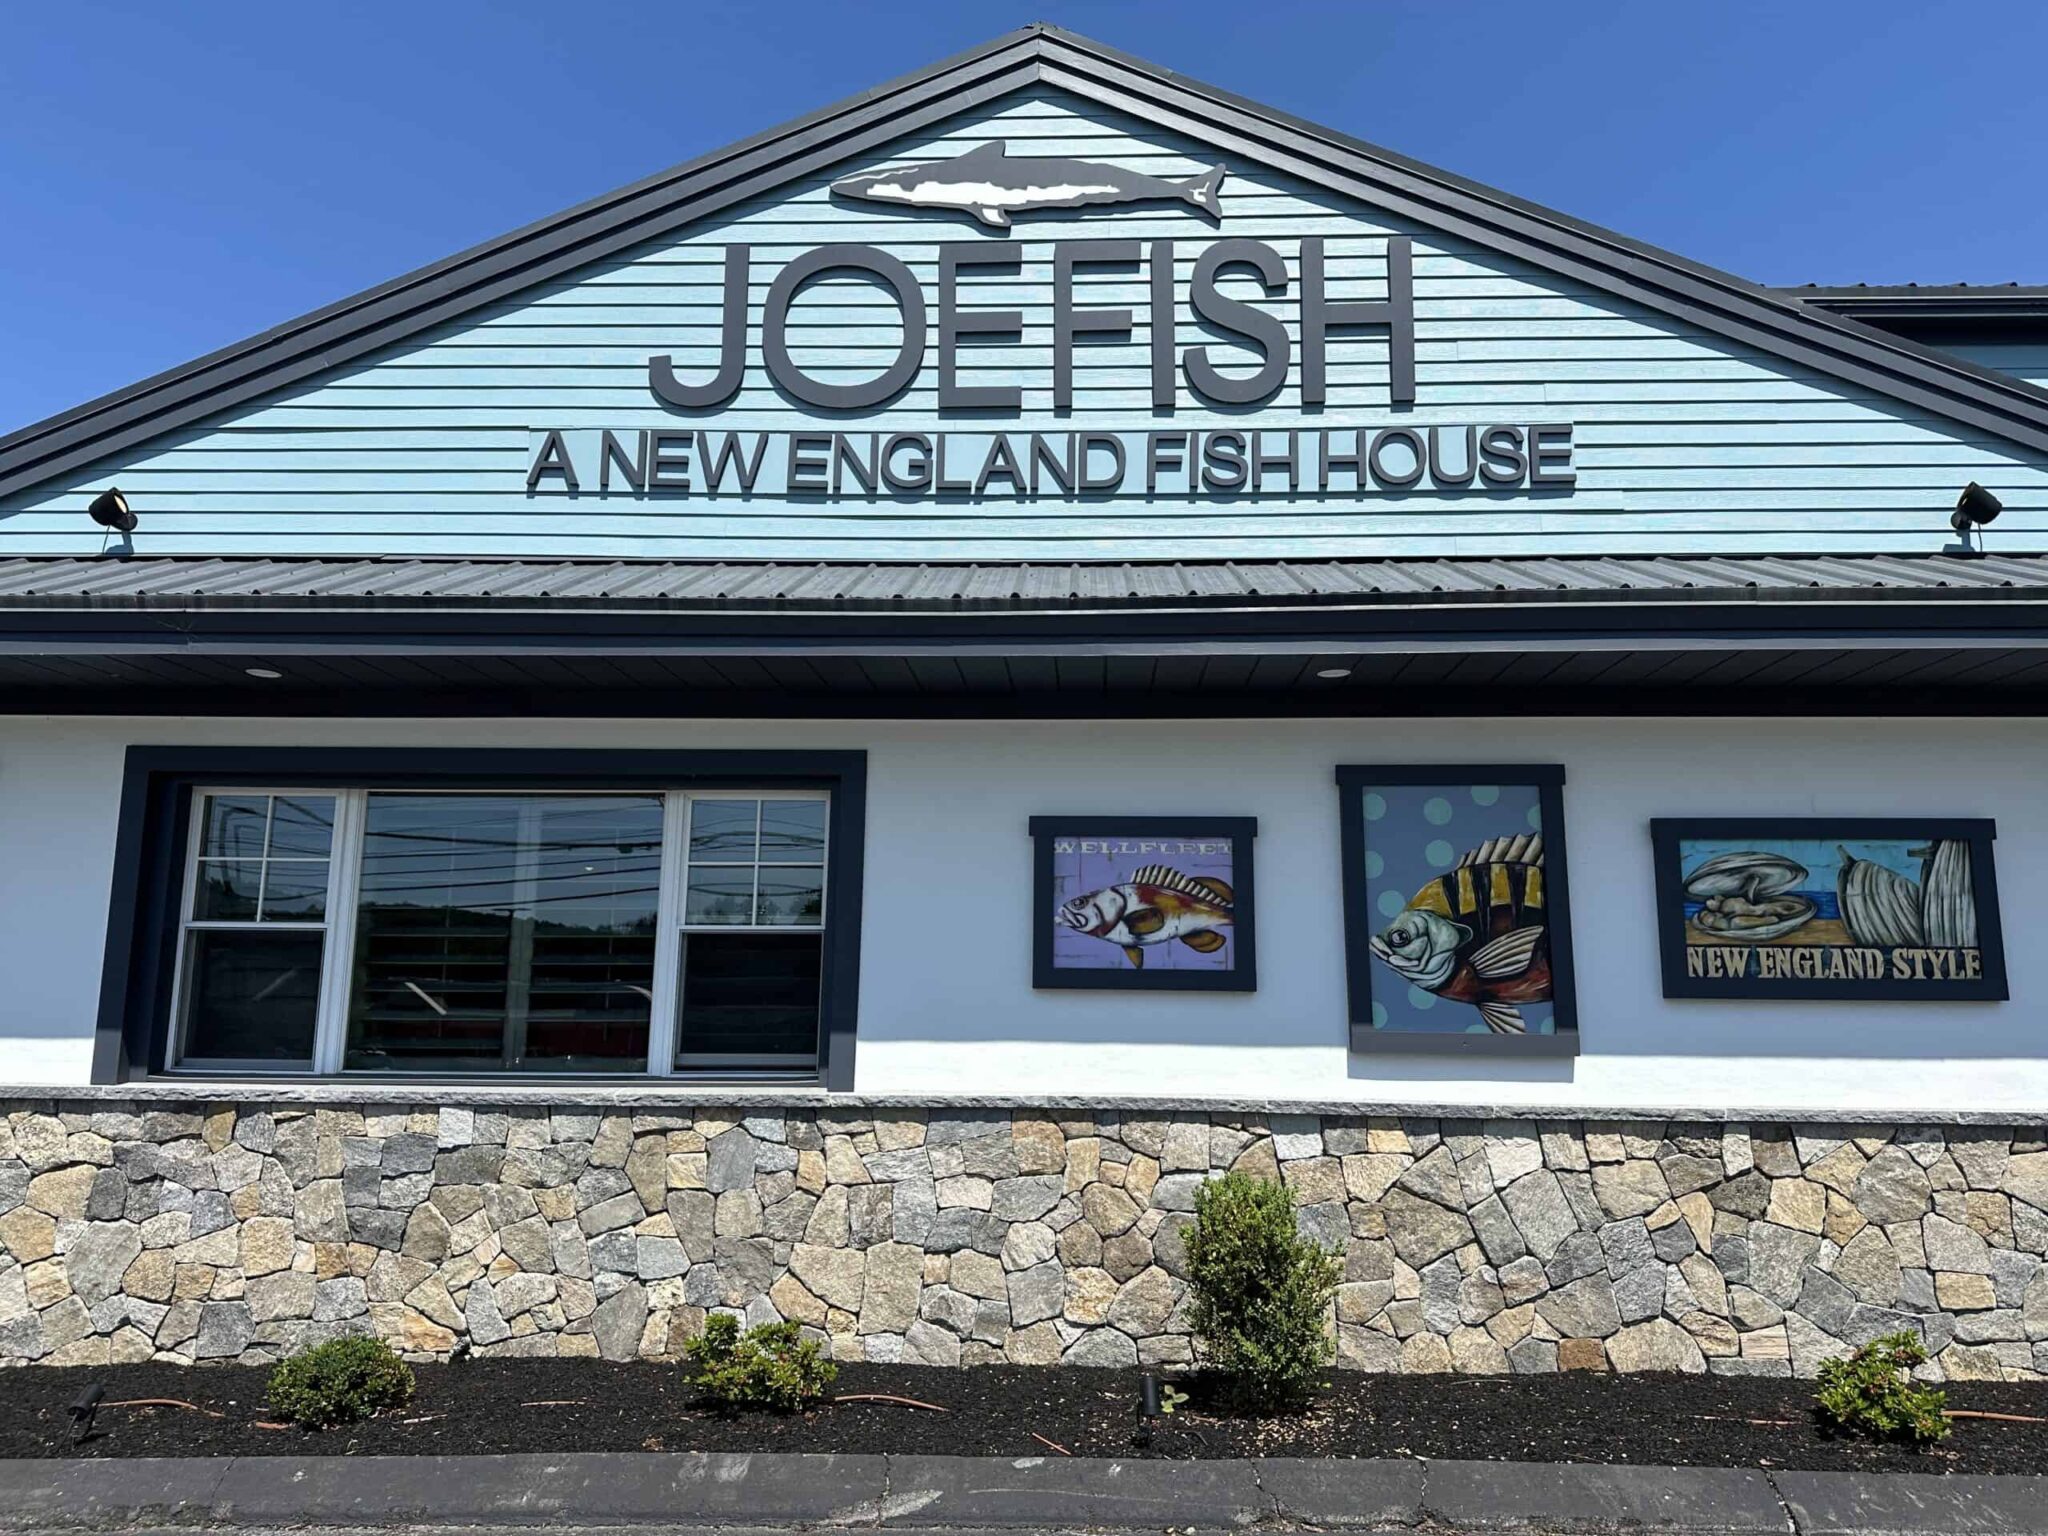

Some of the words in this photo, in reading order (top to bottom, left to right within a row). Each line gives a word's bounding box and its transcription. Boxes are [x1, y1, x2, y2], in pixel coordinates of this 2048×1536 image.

[649, 243, 1022, 408] JOE
[1053, 236, 1415, 406] FISH
[526, 430, 580, 487] A
[600, 430, 769, 488] NEW
[787, 430, 1126, 491] ENGLAND
[1147, 430, 1299, 488] FISH
[1319, 424, 1577, 487] HOUSE
[1687, 946, 1751, 978] NEW
[1757, 947, 1884, 980] ENGLAND
[1891, 948, 1983, 980] STYLE
